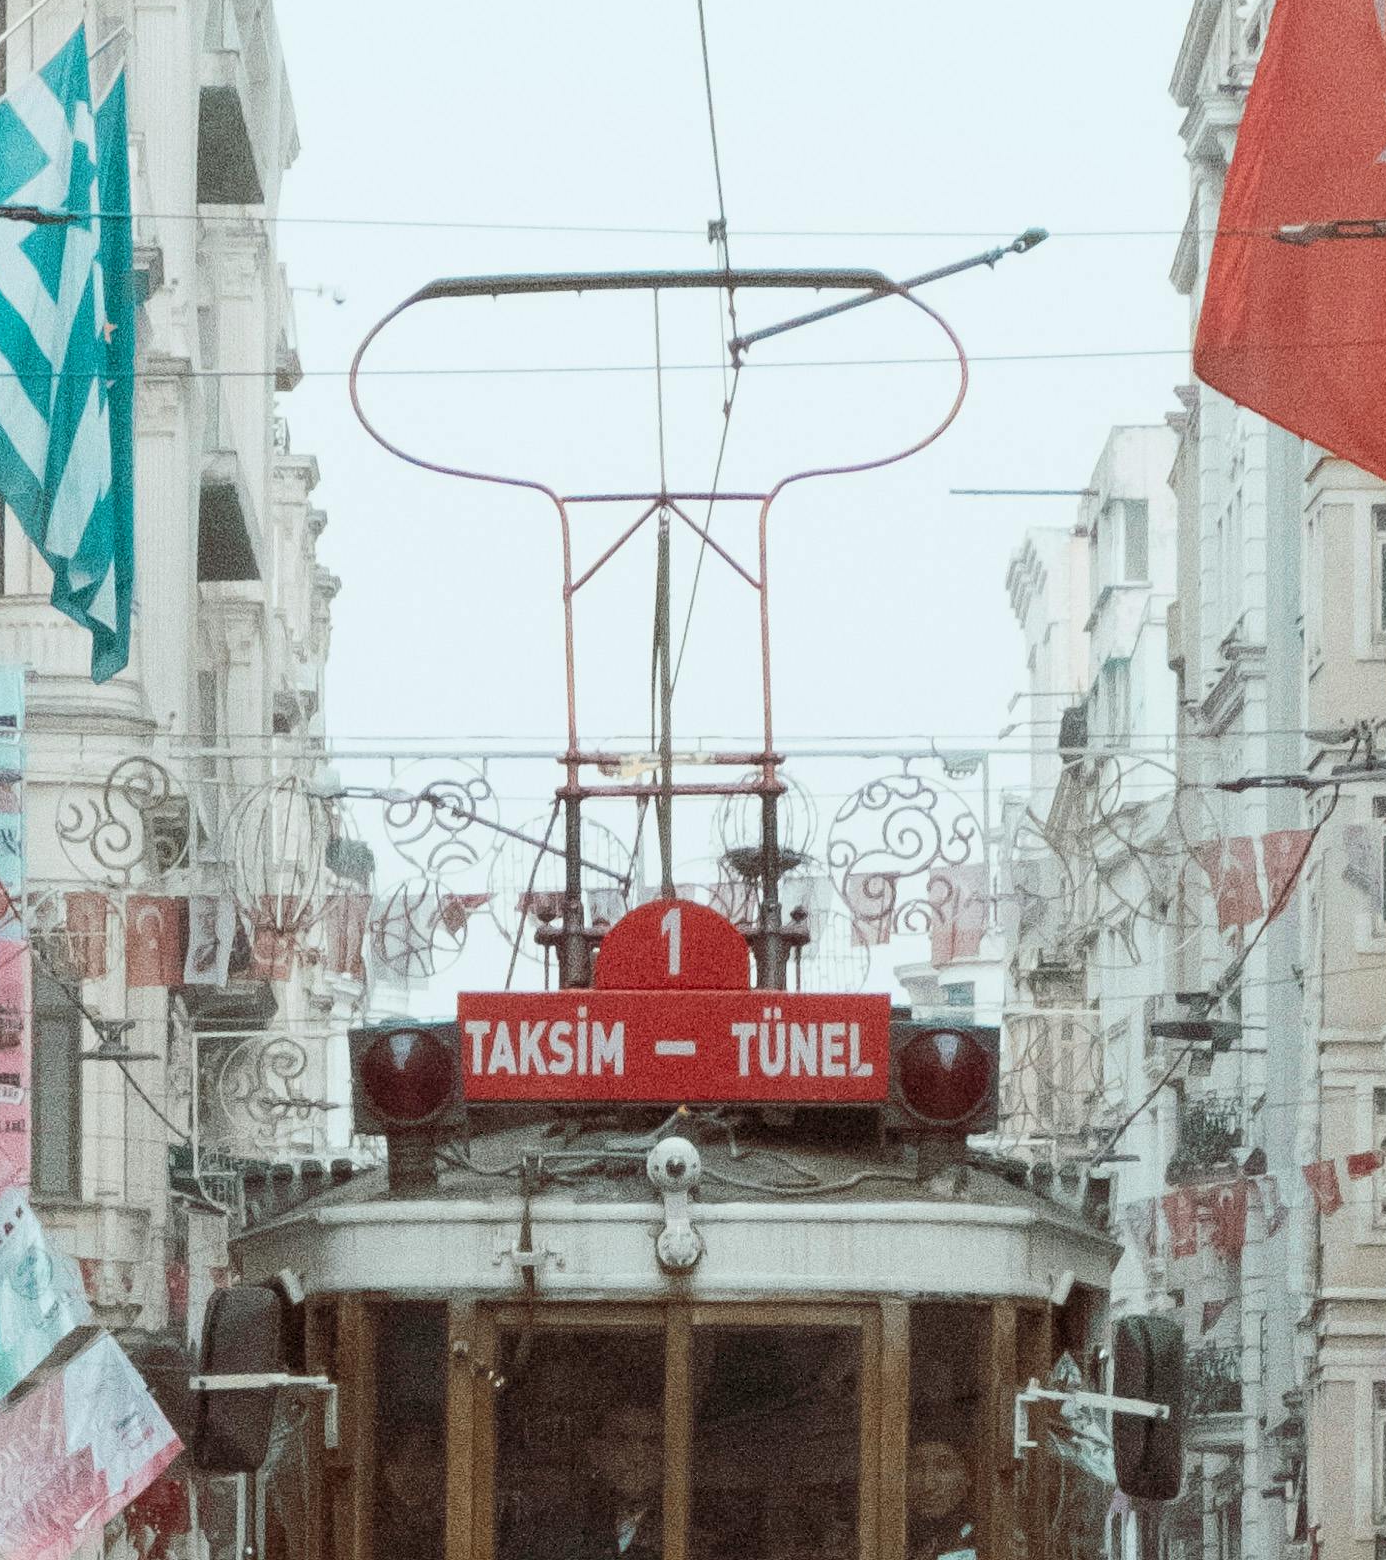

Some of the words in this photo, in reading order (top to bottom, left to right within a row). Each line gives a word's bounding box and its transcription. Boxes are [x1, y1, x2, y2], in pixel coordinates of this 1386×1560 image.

[662, 907, 682, 976] 1
[464, 1006, 625, 1077] TAKSİM
[731, 1007, 874, 1078] TÜNEL
